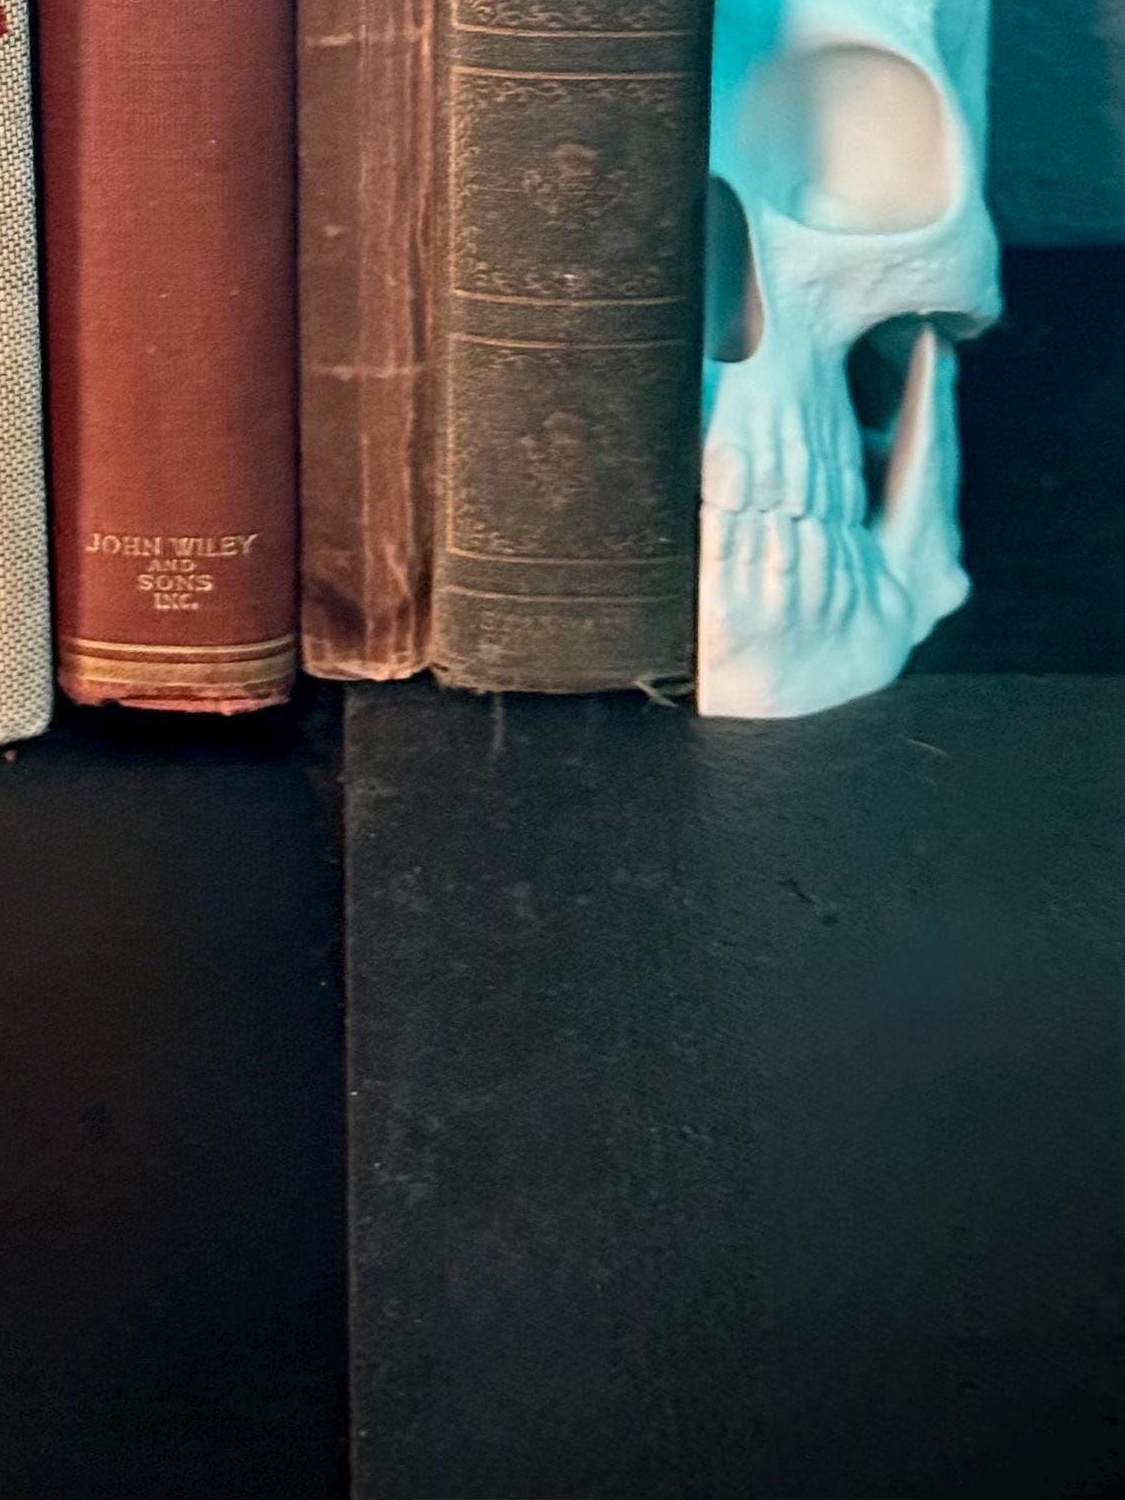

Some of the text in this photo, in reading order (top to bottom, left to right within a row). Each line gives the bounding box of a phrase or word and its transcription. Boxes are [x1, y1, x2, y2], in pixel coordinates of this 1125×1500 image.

[84, 533, 260, 556] JOHN WILEY
[147, 559, 197, 572] AND
[136, 574, 215, 591] SONS
